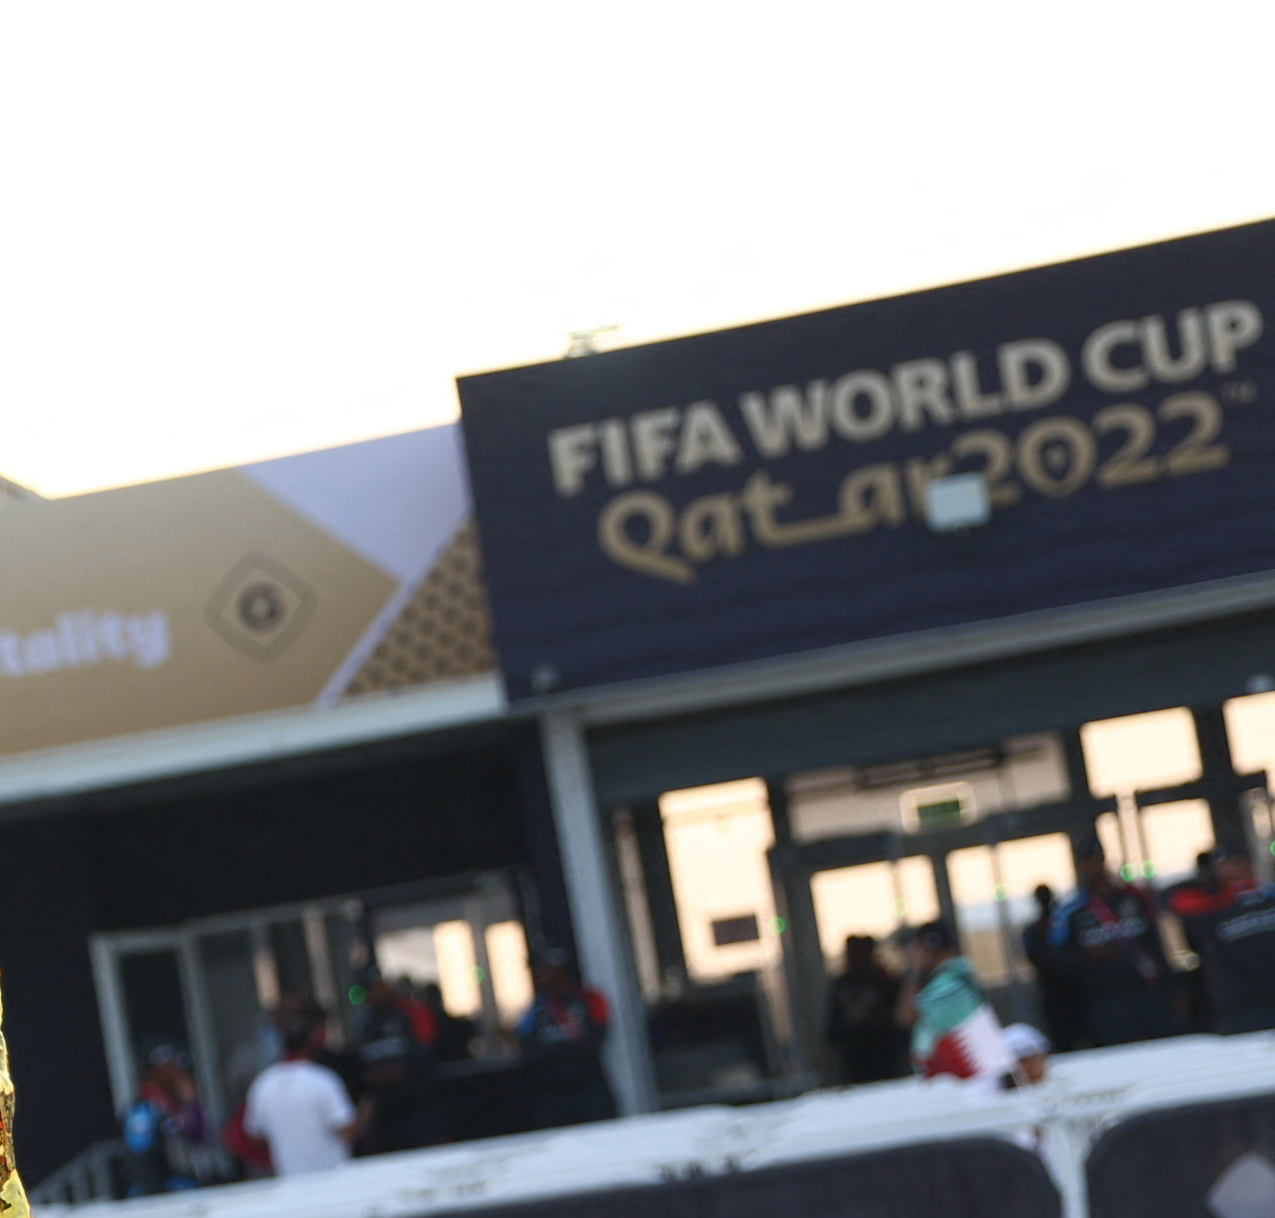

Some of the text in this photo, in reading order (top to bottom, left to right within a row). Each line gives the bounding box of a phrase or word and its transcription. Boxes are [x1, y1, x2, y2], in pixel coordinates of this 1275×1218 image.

[547, 299, 1263, 497] FIFA WORLD CUP
